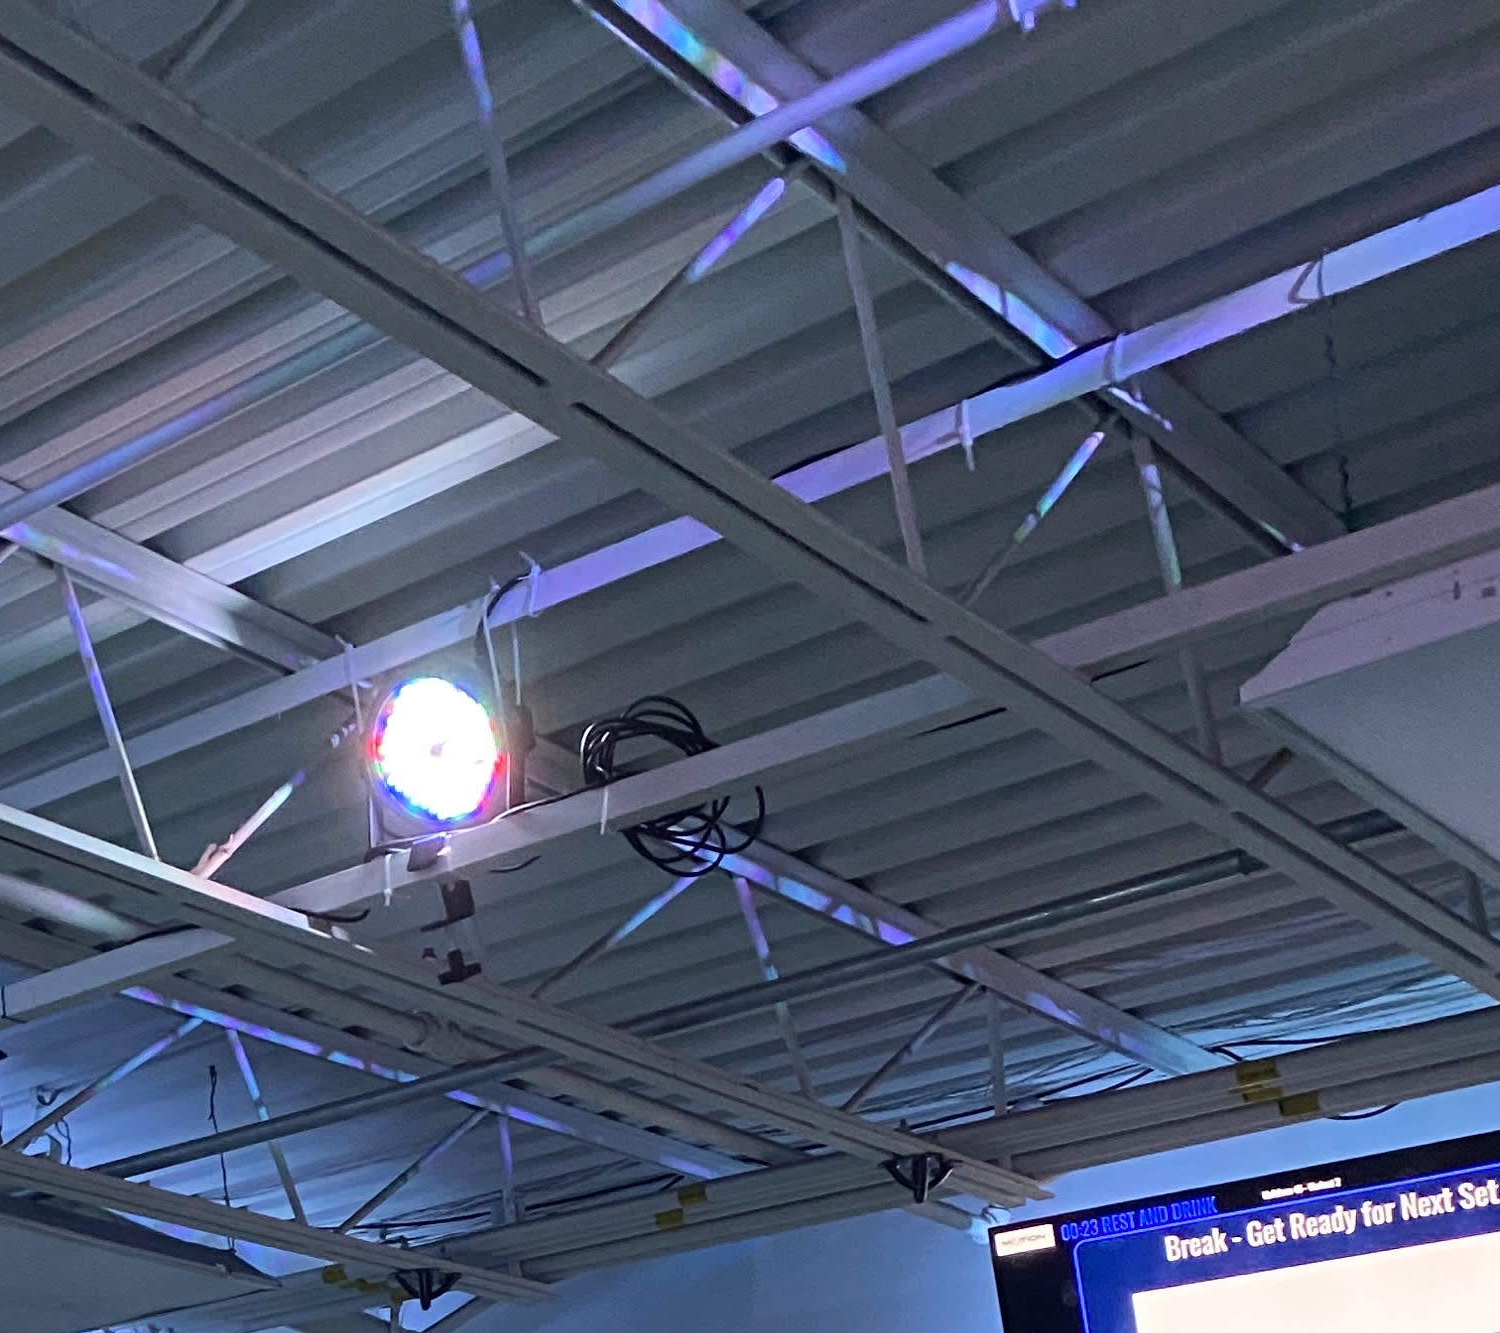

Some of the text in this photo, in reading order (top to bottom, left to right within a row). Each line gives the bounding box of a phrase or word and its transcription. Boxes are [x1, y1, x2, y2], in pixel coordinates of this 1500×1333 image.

[1060, 1196, 1218, 1242] 00:23 REST AND DRINK
[1164, 1228, 1228, 1262] Break
[1245, 1220, 1286, 1248] Get
[1289, 1205, 1357, 1240] Ready
[1361, 1201, 1397, 1227] for
[1399, 1187, 1456, 1221] Next
[1458, 1179, 1500, 1211] Set
